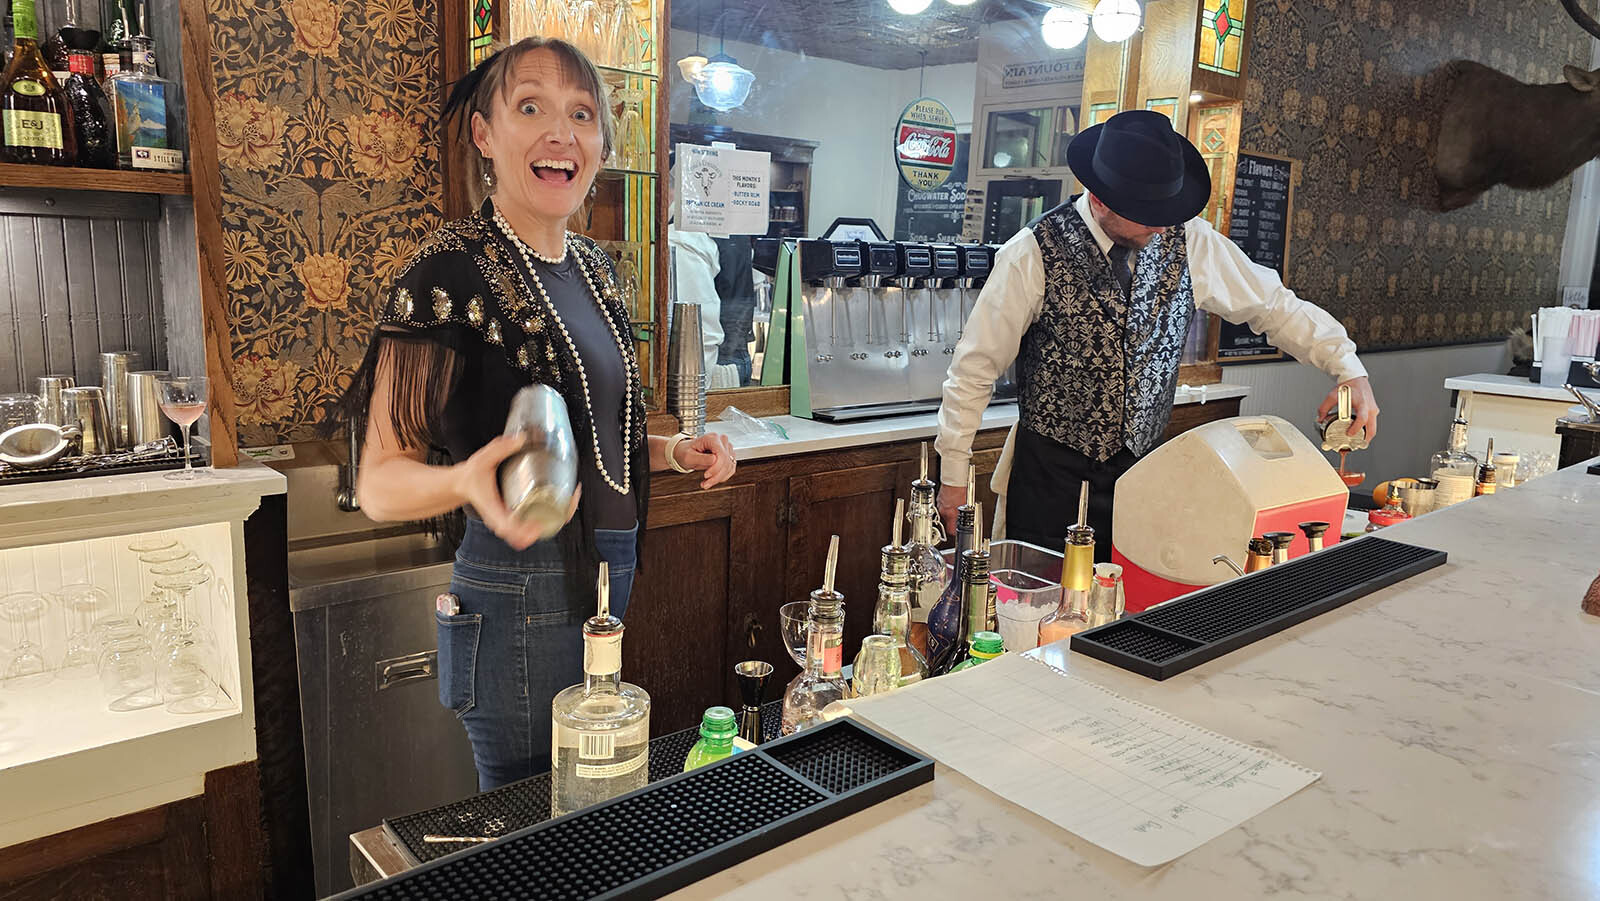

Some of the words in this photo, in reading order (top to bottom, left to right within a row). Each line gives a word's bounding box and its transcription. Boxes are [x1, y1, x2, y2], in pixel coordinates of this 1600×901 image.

[915, 104, 934, 114] PLEASE
[911, 111, 927, 121] WHEN
[928, 115, 949, 125] SERVED
[21, 119, 44, 130] E&J
[913, 170, 939, 180] THANK
[918, 179, 933, 187] YOU
[950, 189, 966, 202] SOD
